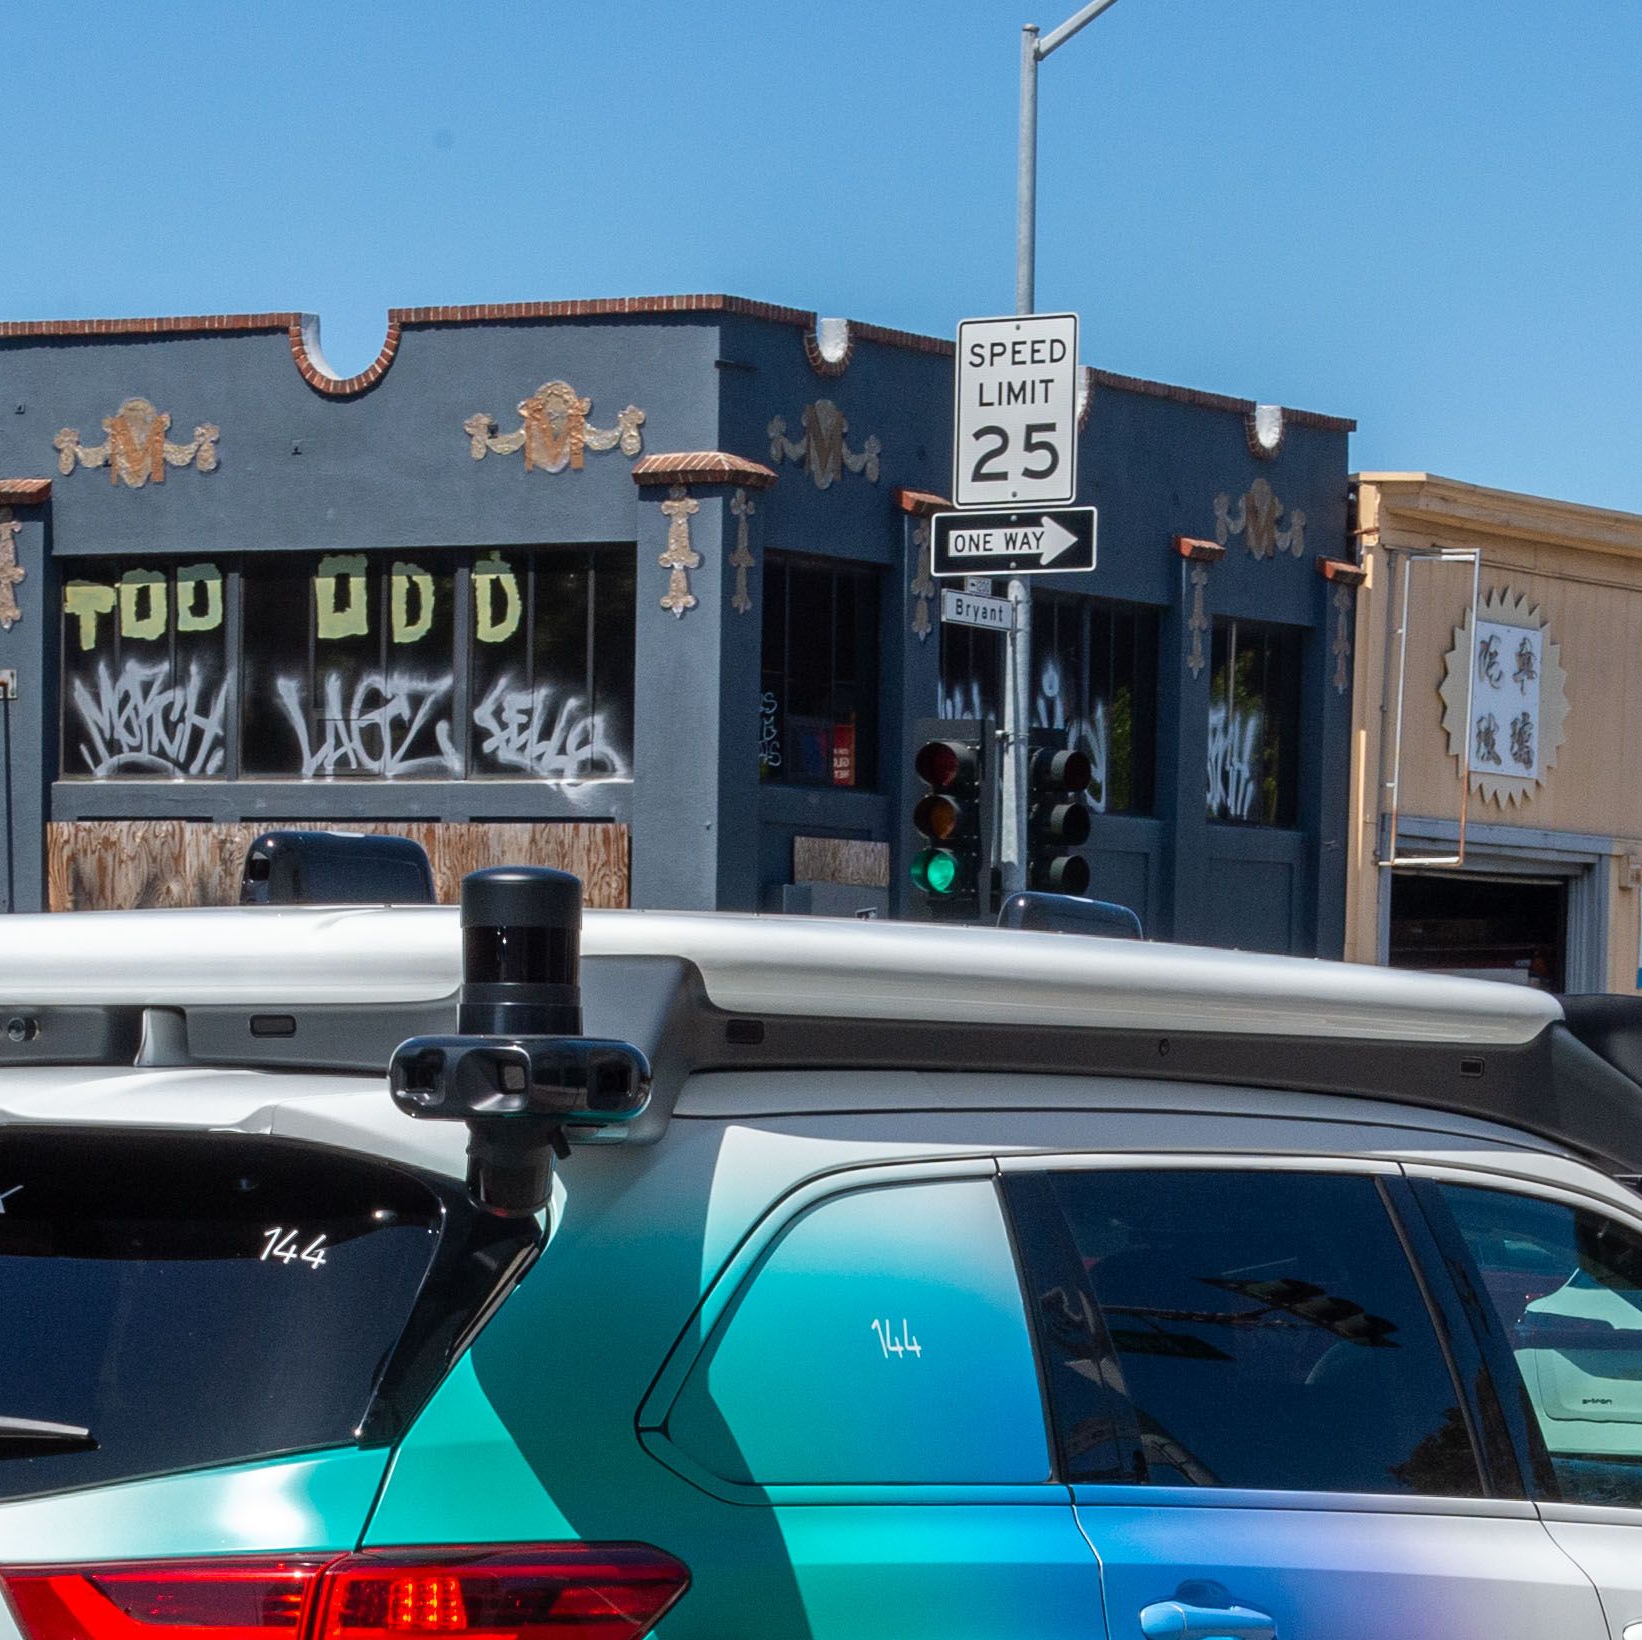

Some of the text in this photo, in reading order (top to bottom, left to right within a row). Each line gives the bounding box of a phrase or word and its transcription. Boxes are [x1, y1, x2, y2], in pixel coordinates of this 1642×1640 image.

[968, 338, 1067, 368] SPEED
[978, 379, 1055, 407] LIMIT
[971, 422, 1060, 482] 25
[954, 530, 1045, 553] ONE WAY
[955, 598, 1003, 622] Bryant
[259, 1226, 328, 1269] 144
[871, 1318, 922, 1359] 144
